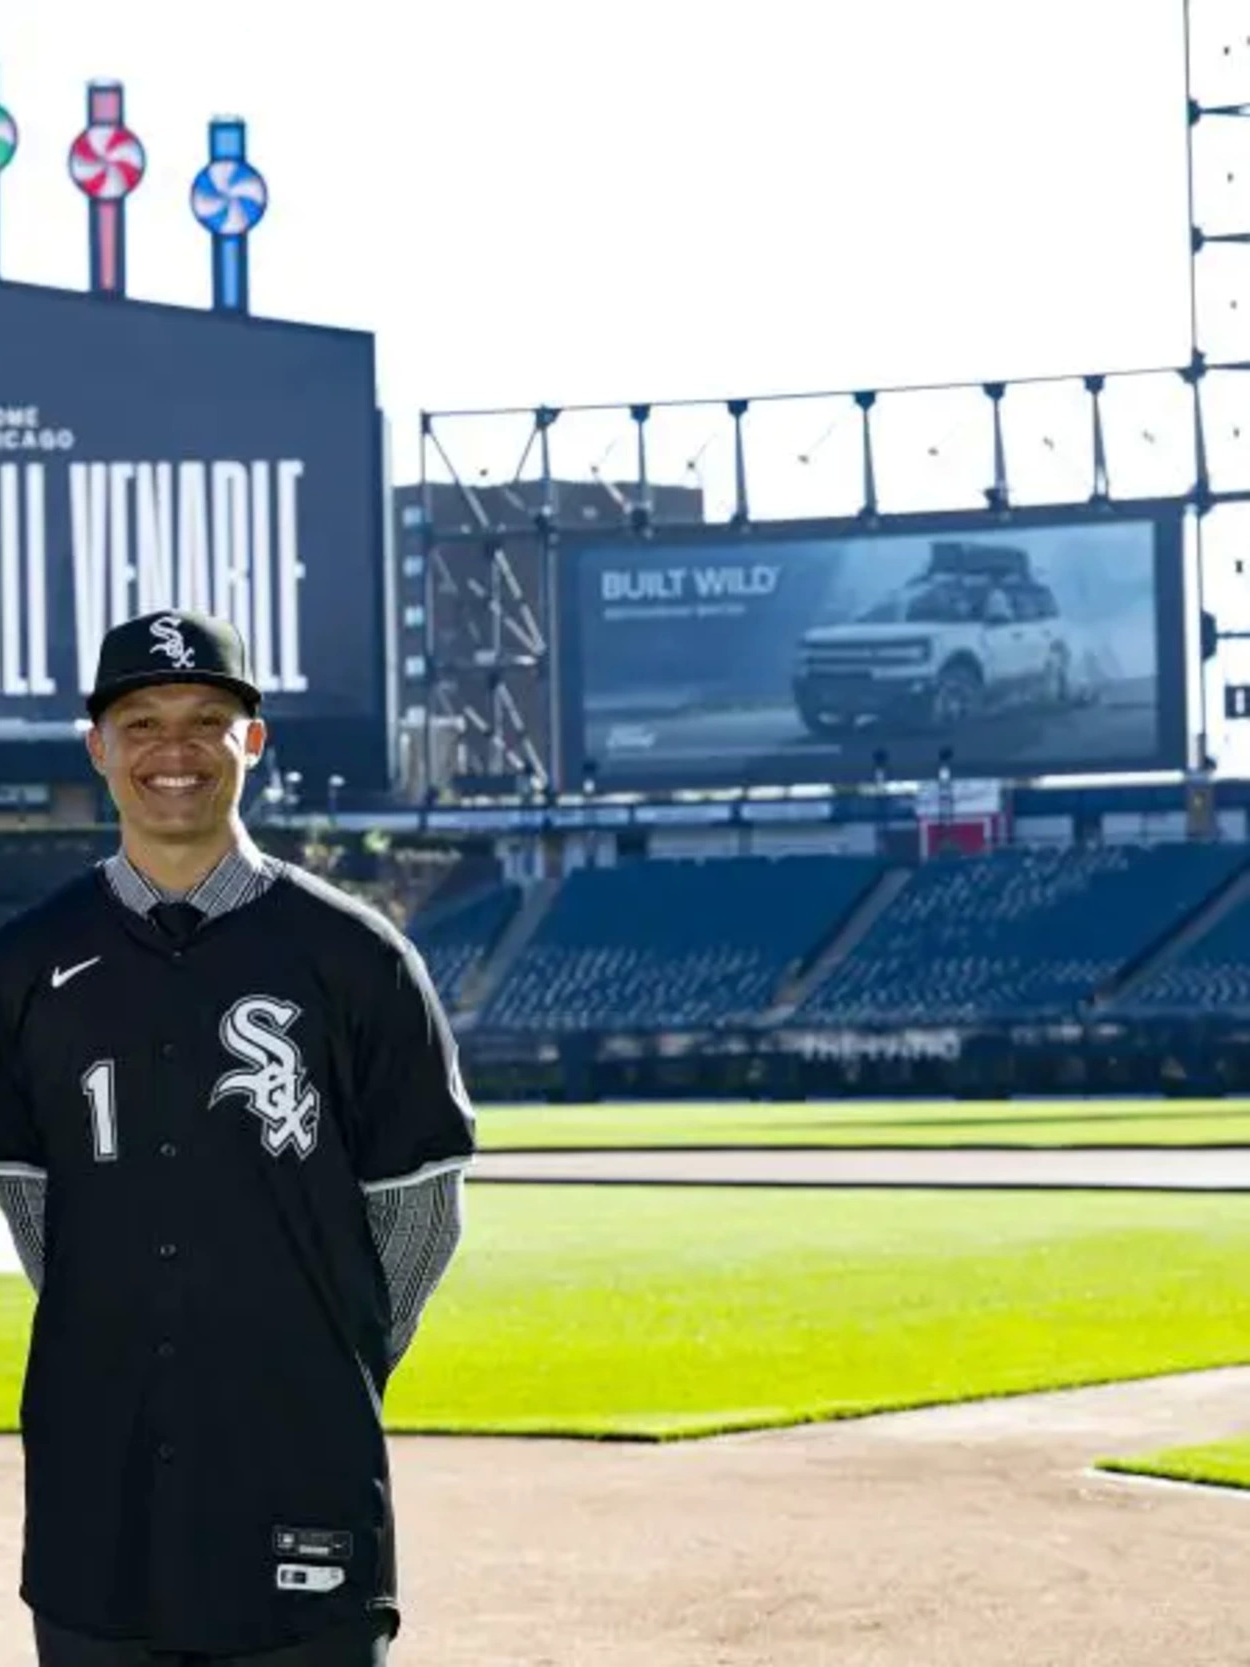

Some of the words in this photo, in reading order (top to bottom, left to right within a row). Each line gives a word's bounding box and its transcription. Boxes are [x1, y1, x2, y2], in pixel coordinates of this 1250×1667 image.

[69, 459, 309, 696] VENABLE
[602, 567, 687, 600] BUILT
[692, 565, 780, 598] WILD
[80, 1058, 118, 1162] 1
[207, 994, 320, 1163] Sox
